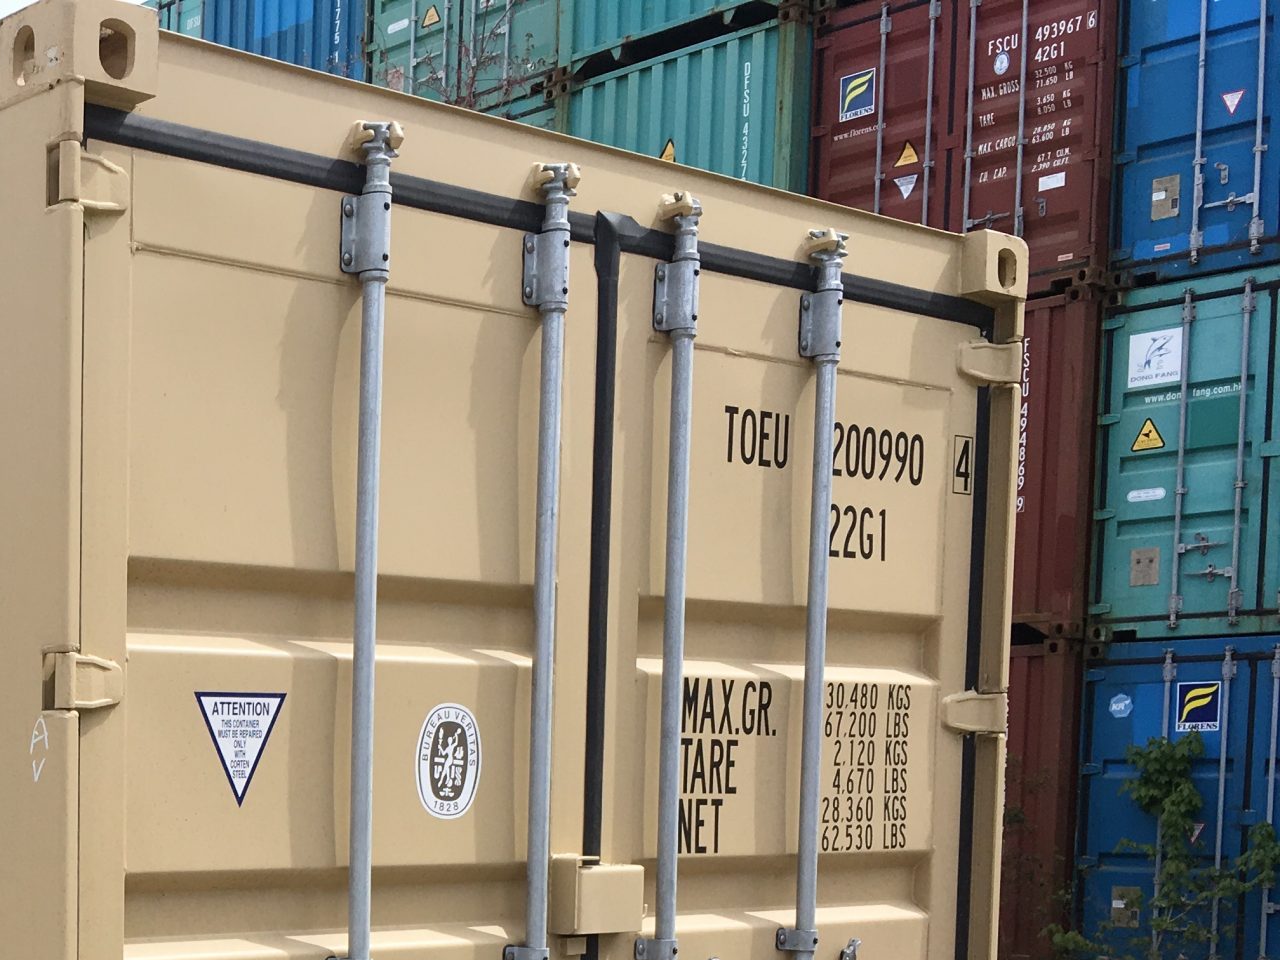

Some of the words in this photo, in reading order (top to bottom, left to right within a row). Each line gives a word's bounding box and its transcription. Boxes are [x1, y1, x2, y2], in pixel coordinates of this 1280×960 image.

[988, 34, 1018, 56] FSCU
[1035, 16, 1083, 42] 493967
[1088, 12, 1096, 28] 6
[1035, 41, 1065, 63] 42G1
[1064, 61, 1074, 71] KG
[743, 62, 751, 117] DFSU
[999, 79, 1020, 96] GROSS
[1035, 76, 1058, 89] 71.650
[1065, 71, 1074, 81] LB
[1062, 88, 1071, 98] KG
[841, 107, 874, 120] FLORENS
[979, 113, 996, 128] TARE
[833, 122, 887, 141] www.florens.cm
[741, 122, 749, 181] 4327
[995, 135, 1016, 152] CARGO
[1022, 337, 1031, 397] FSCU
[1130, 374, 1154, 384] DONG
[1155, 370, 1179, 381] FANG
[725, 405, 790, 469] TOEU
[832, 421, 925, 486] 200990
[955, 440, 970, 492] 4
[1017, 402, 1028, 491] 494869
[829, 503, 887, 562] 22G1
[887, 684, 912, 710] KGS
[212, 702, 270, 716] ATTENTION
[218, 729, 231, 738] MUST
[232, 730, 238, 738] BE
[240, 730, 262, 738] REPAIRED
[221, 719, 232, 728] THIS
[233, 720, 259, 728] CONTAINER
[886, 712, 910, 738] LBS
[1177, 722, 1218, 731] FLORENS
[234, 740, 246, 748] ONLY
[422, 710, 450, 761] BUREAU
[454, 711, 476, 766] VERITAS
[230, 760, 249, 769] CORTEN
[234, 750, 246, 758] WITH
[885, 740, 908, 766] KGS
[232, 770, 247, 778] STEEL
[681, 738, 738, 794] TARE
[884, 768, 908, 794] LBS
[433, 800, 459, 812] 1828
[883, 795, 907, 822] KGS
[678, 797, 723, 854] NET
[882, 823, 907, 849] LBS
